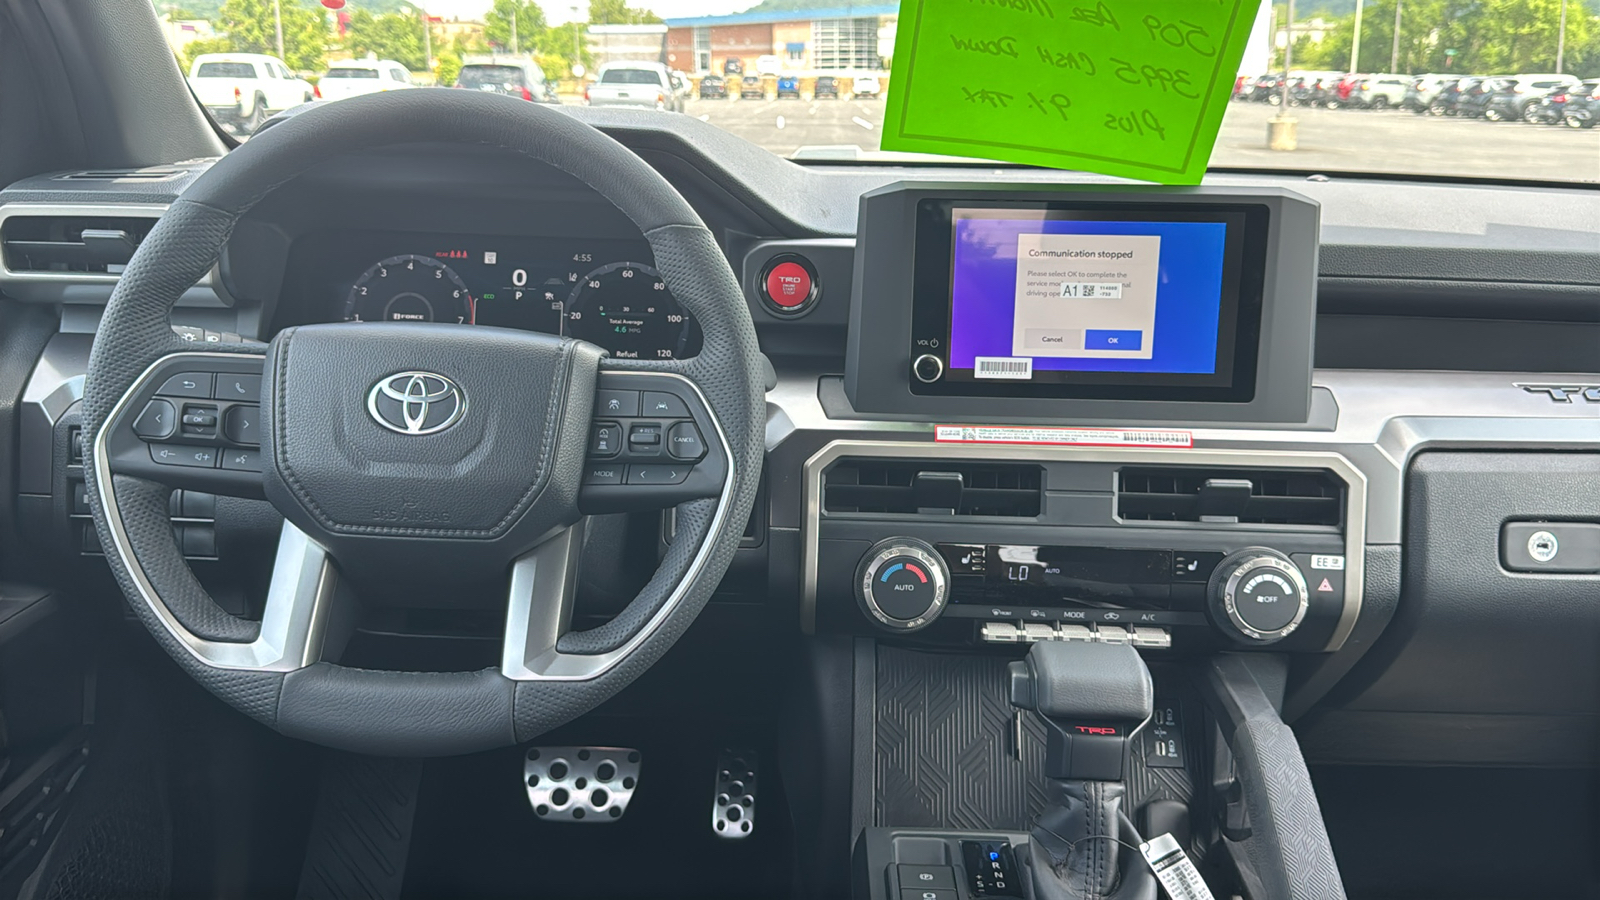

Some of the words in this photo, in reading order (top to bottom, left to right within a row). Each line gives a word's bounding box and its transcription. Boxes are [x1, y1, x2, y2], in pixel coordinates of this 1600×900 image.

[573, 254, 592, 262] 4:55
[1028, 249, 1096, 258] Communication
[1097, 250, 1134, 260] stopped
[407, 262, 414, 270] 4
[381, 269, 388, 277] 3
[435, 270, 443, 279] 5
[622, 270, 634, 278] 60
[1086, 271, 1116, 279] complete
[512, 268, 527, 287] 0
[588, 280, 600, 288] 40
[653, 282, 665, 290] 80
[361, 287, 368, 295] 2
[453, 290, 460, 298] 6
[1063, 285, 1078, 297] A1
[515, 291, 523, 300] P
[458, 316, 464, 325] 7
[657, 349, 672, 357] 120
[1316, 557, 1329, 567] EE
[1063, 611, 1085, 619] MODE
[1141, 613, 1156, 621] A/C
[1075, 725, 1116, 735] TRD
[989, 851, 999, 860] P
[994, 871, 1004, 879] N
